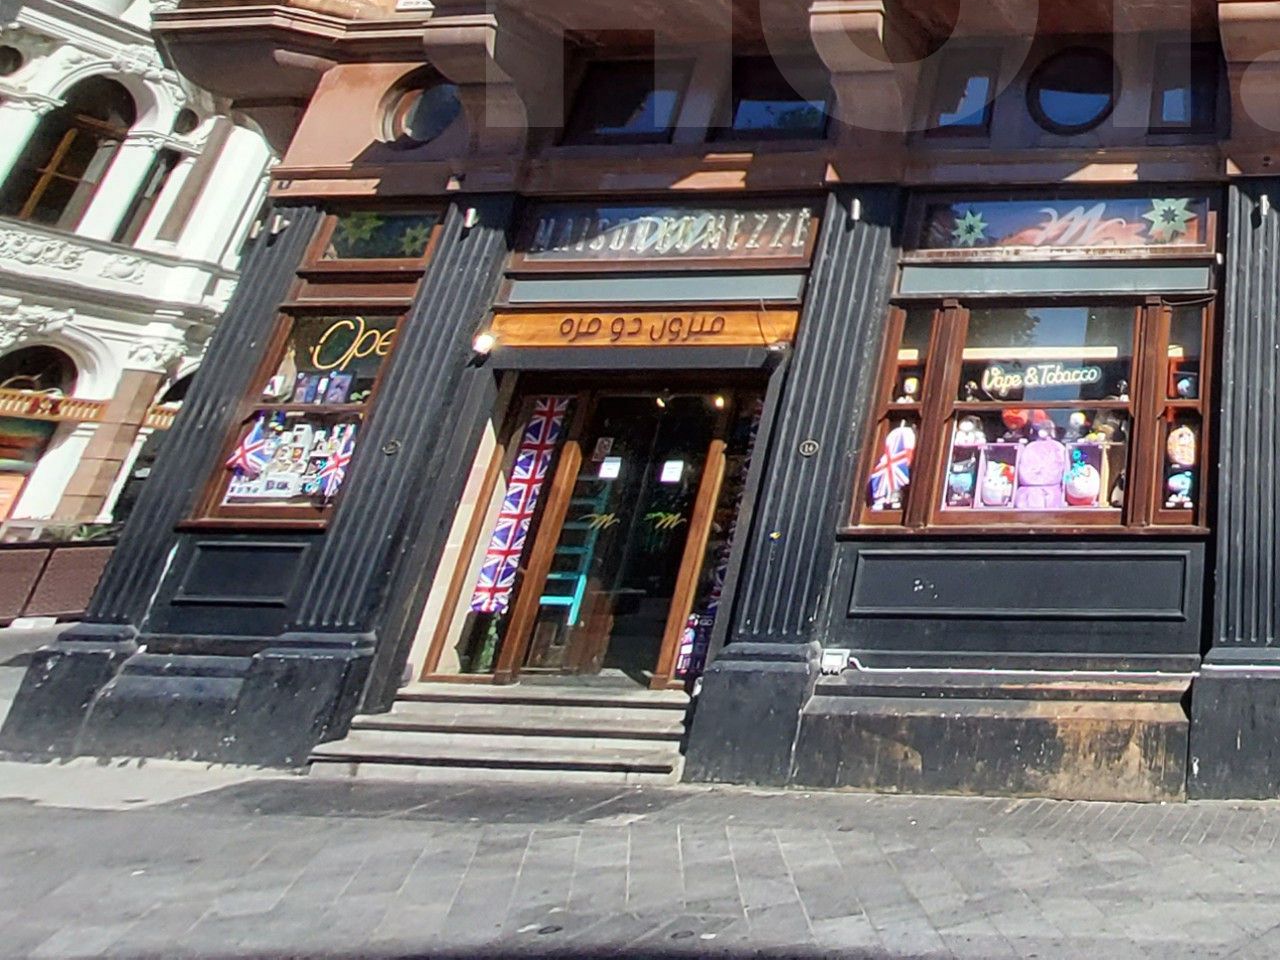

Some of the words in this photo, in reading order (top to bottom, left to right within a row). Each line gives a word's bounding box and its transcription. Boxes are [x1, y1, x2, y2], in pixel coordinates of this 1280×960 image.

[981, 367, 1022, 397] Vape
[1023, 367, 1038, 387] &
[1037, 364, 1102, 385] Tobacco
